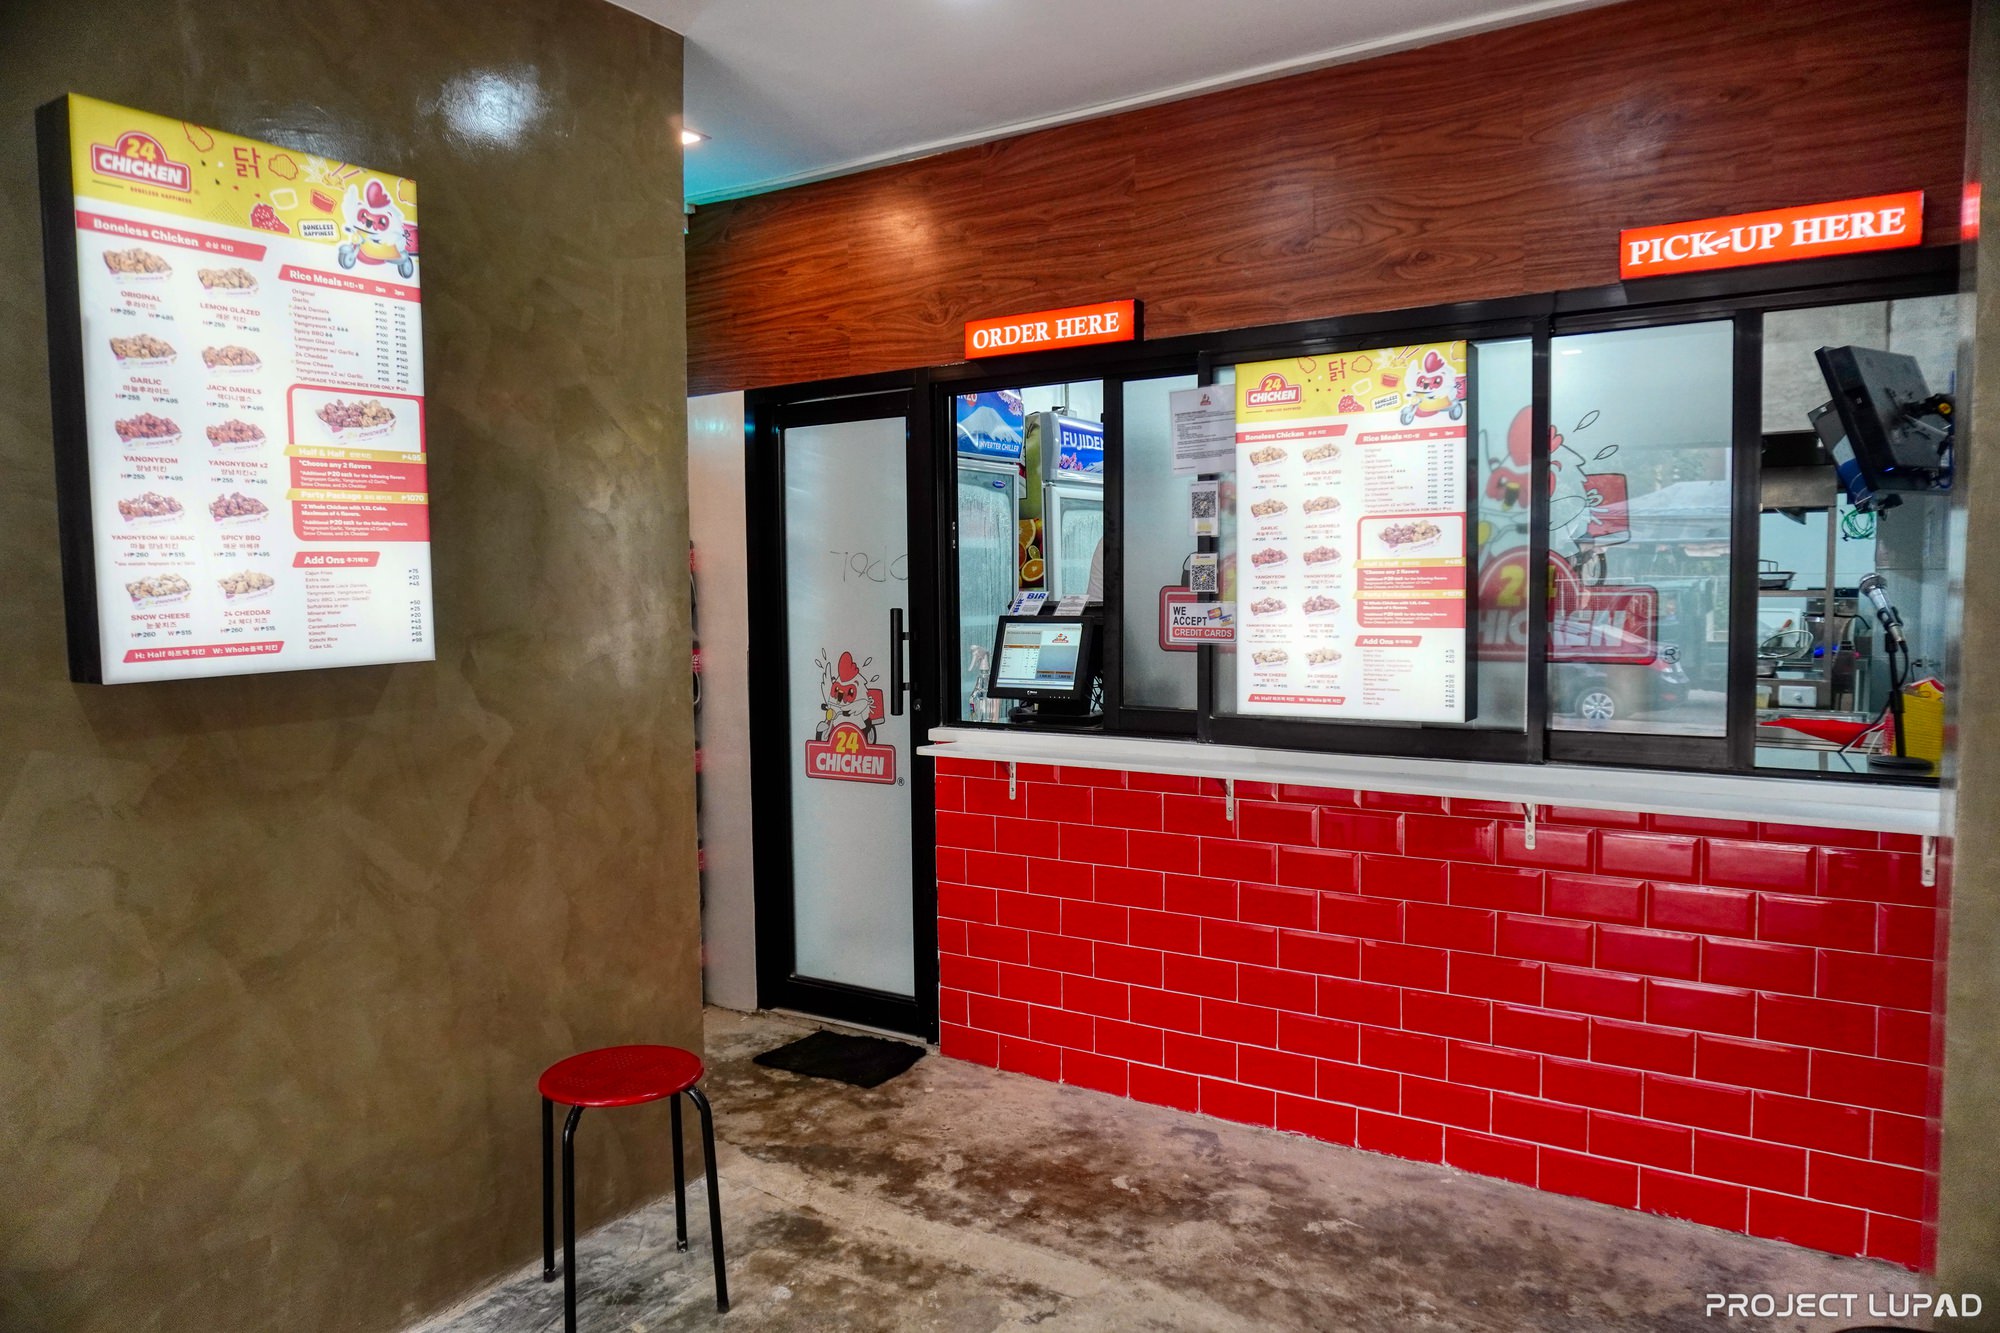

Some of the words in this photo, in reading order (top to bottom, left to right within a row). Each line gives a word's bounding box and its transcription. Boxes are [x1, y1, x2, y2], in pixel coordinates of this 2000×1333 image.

[127, 137, 157, 162] 24
[100, 153, 182, 185] CHICKEN
[233, 147, 261, 178] 닭
[93, 218, 149, 238] Boneless
[151, 231, 199, 247] Chicken
[1628, 222, 1784, 266] PICK-UP
[1790, 208, 1906, 246] HERE
[290, 270, 311, 281] Rice
[314, 274, 342, 287] Meals
[121, 290, 162, 302] ORIGINAL
[200, 302, 228, 312] LEMON
[972, 322, 1051, 349] ORDER
[1056, 312, 1120, 339] HERE
[1329, 358, 1346, 382] 닭
[130, 376, 162, 386] GARLIC
[1265, 378, 1281, 391] 24
[206, 384, 227, 392] JACK
[230, 386, 262, 395] DANIELS
[1250, 390, 1296, 403] CHICKEN
[1276, 430, 1304, 438] Chicken
[978, 440, 1001, 450] INVERTER
[1002, 444, 1020, 452] CHILLER
[304, 556, 324, 564] Add
[326, 556, 345, 564] Ons
[1173, 606, 1186, 616] WE
[1173, 616, 1207, 626] ACCEPT
[1204, 629, 1232, 637] CARDS
[148, 650, 166, 658] Half
[836, 732, 858, 753] 24
[816, 753, 884, 775] CHICKEN
